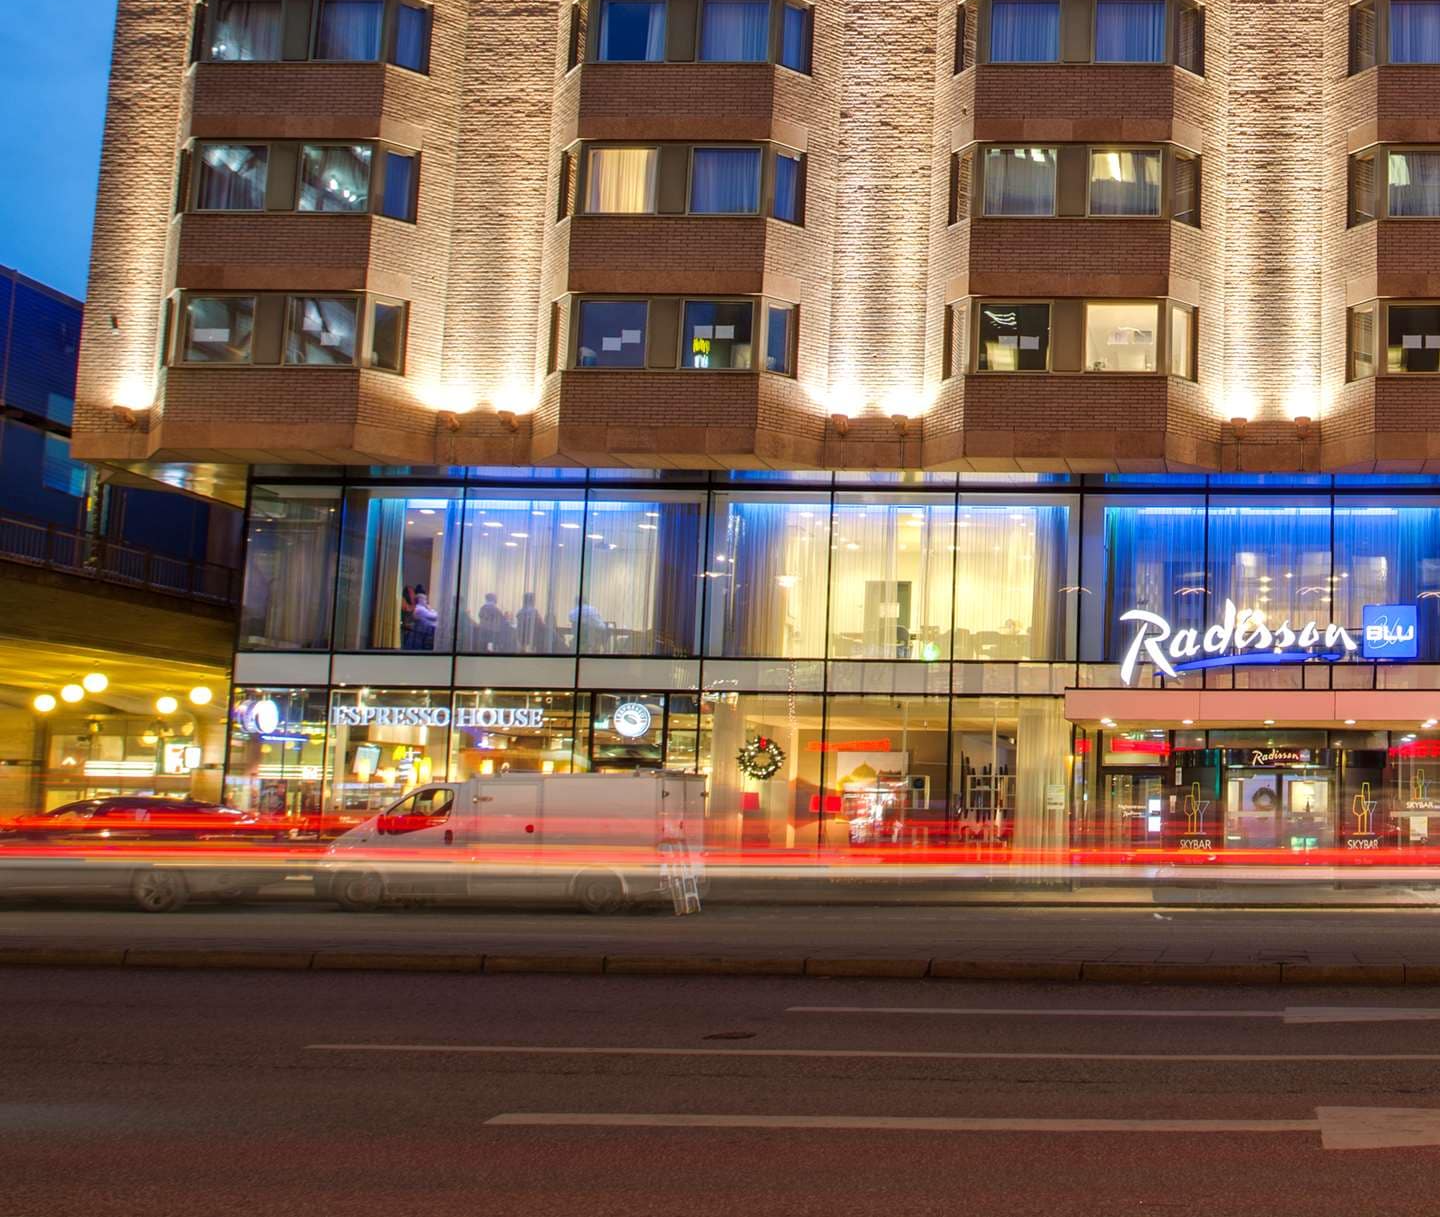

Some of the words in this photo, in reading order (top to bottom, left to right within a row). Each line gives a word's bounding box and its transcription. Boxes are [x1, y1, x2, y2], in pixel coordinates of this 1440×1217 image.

[1119, 598, 1358, 685] Radisson
[1365, 624, 1414, 641] BLU
[332, 706, 451, 726] ESPRESSO
[456, 707, 544, 728] HOUSE
[1252, 748, 1299, 766] Radisson
[1180, 839, 1212, 849] SKYBAR
[1347, 839, 1379, 849] SKYBAR
